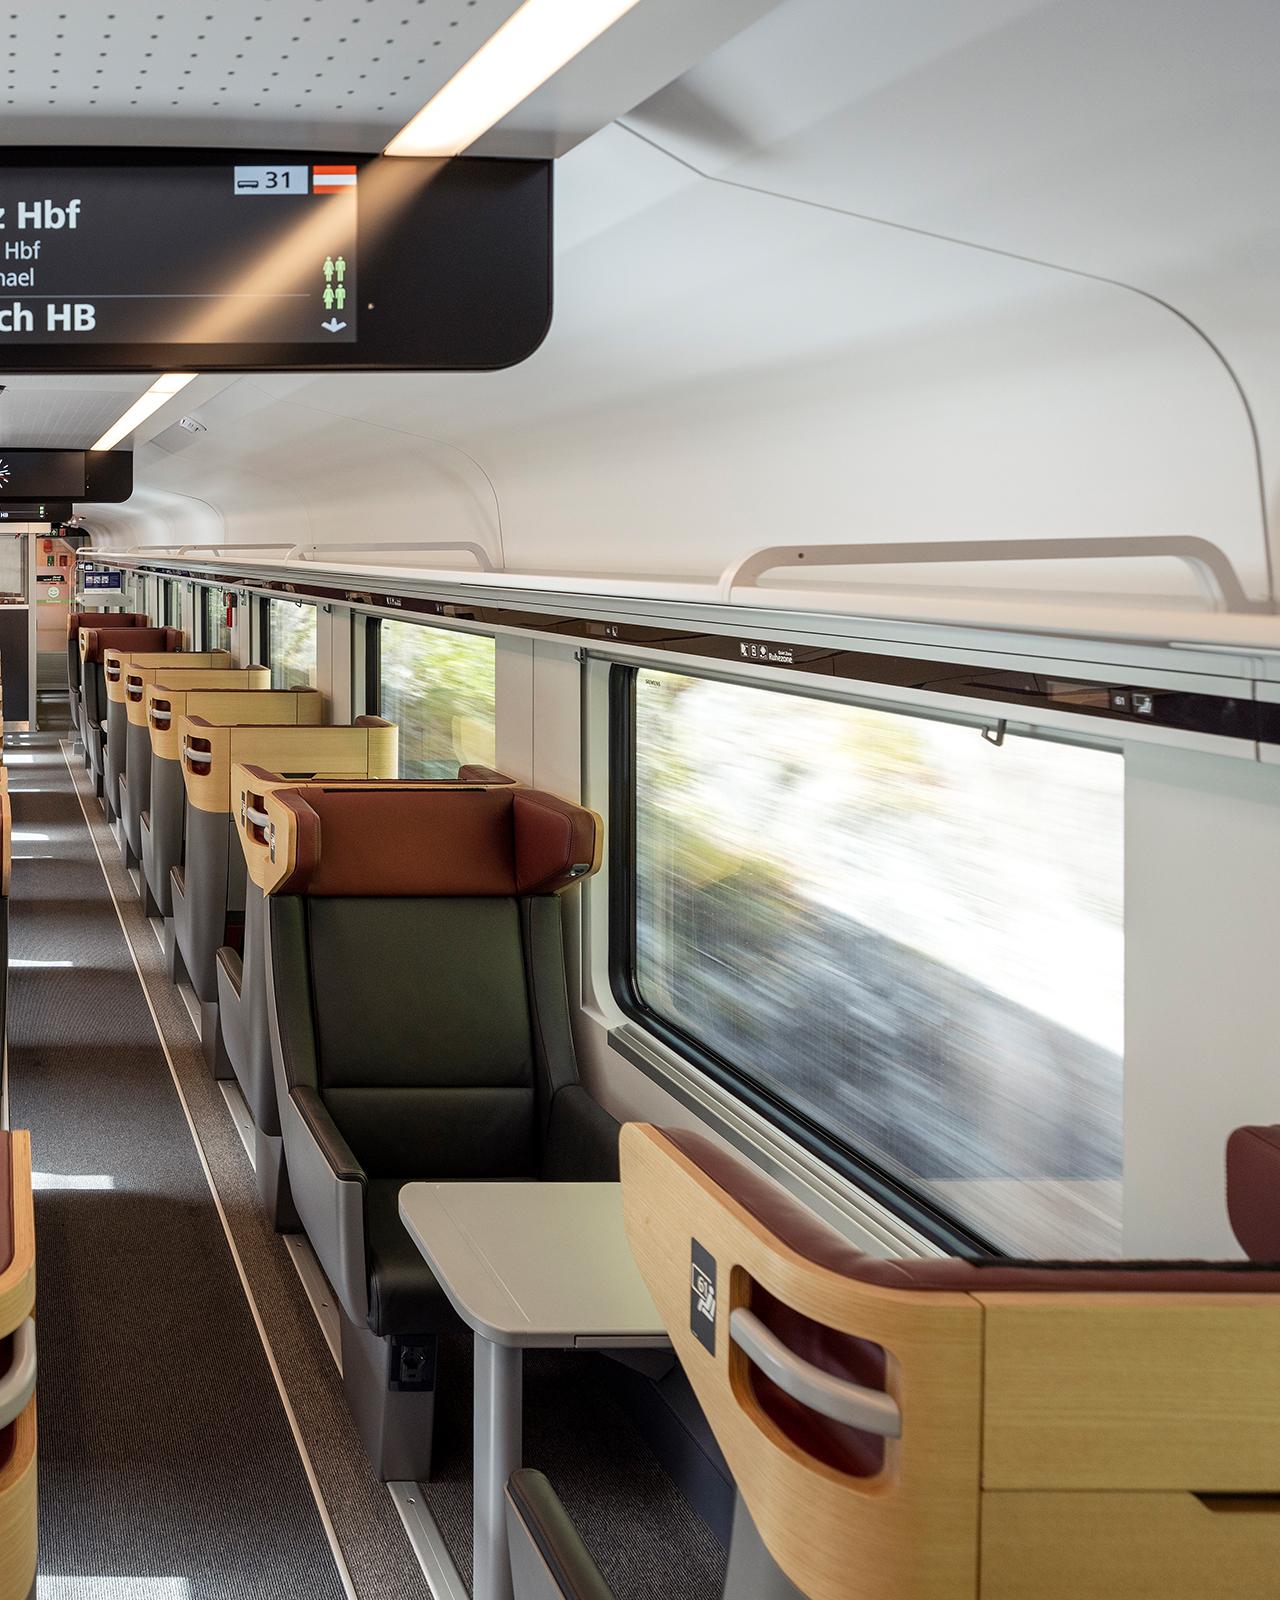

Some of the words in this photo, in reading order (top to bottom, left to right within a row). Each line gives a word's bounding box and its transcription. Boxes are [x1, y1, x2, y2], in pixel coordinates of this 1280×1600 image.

[265, 171, 291, 189] 31
[17, 199, 81, 230] Hbf
[5, 240, 41, 260] Hbf
[47, 303, 96, 331] HB
[769, 653, 793, 663] Ruhezone
[696, 1275, 708, 1297] 61
